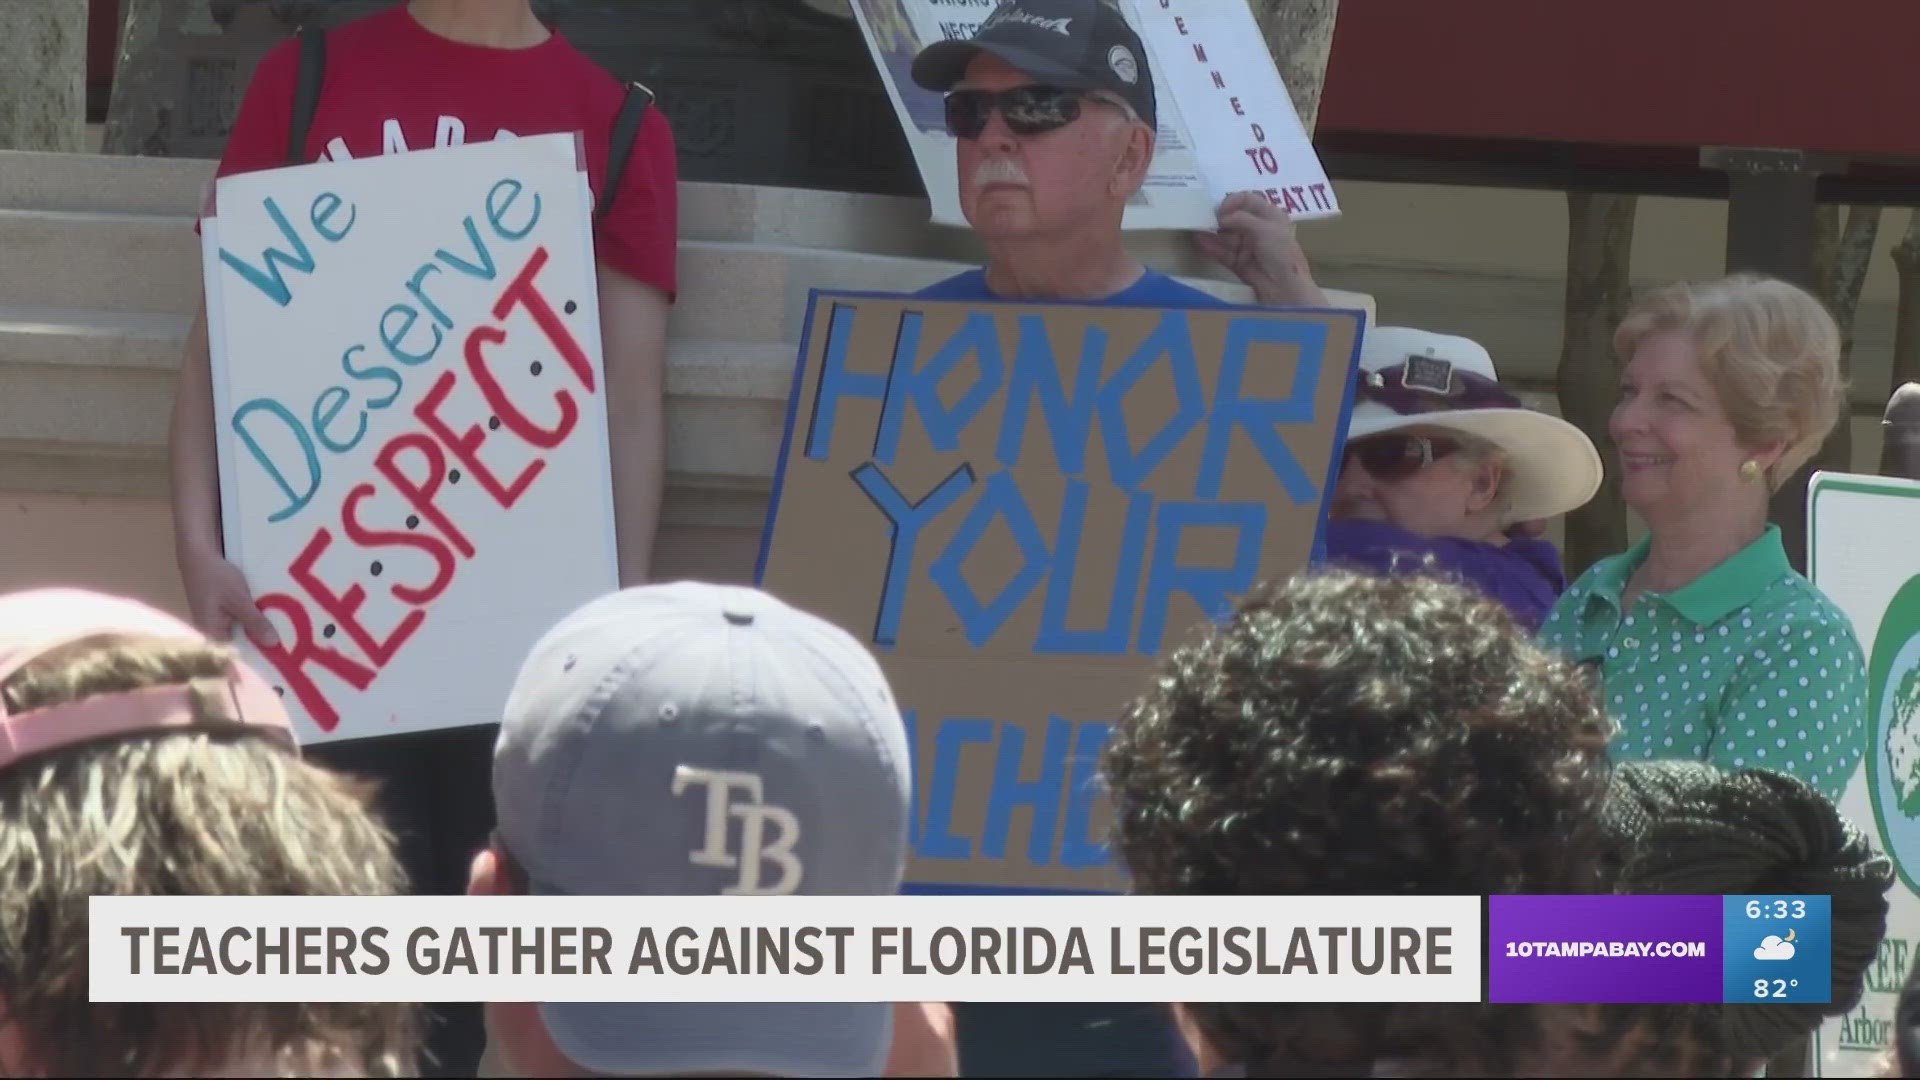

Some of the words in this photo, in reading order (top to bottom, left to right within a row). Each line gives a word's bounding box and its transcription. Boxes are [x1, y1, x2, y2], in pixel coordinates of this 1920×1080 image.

[1245, 146, 1279, 175] TO
[1308, 183, 1332, 211] IT
[219, 191, 356, 307] We
[231, 178, 542, 522] Deserve
[804, 302, 1334, 506] HONOR
[848, 461, 1268, 658] YOUR
[671, 764, 804, 896] TB
[1839, 1005, 1891, 1046] Arbor
